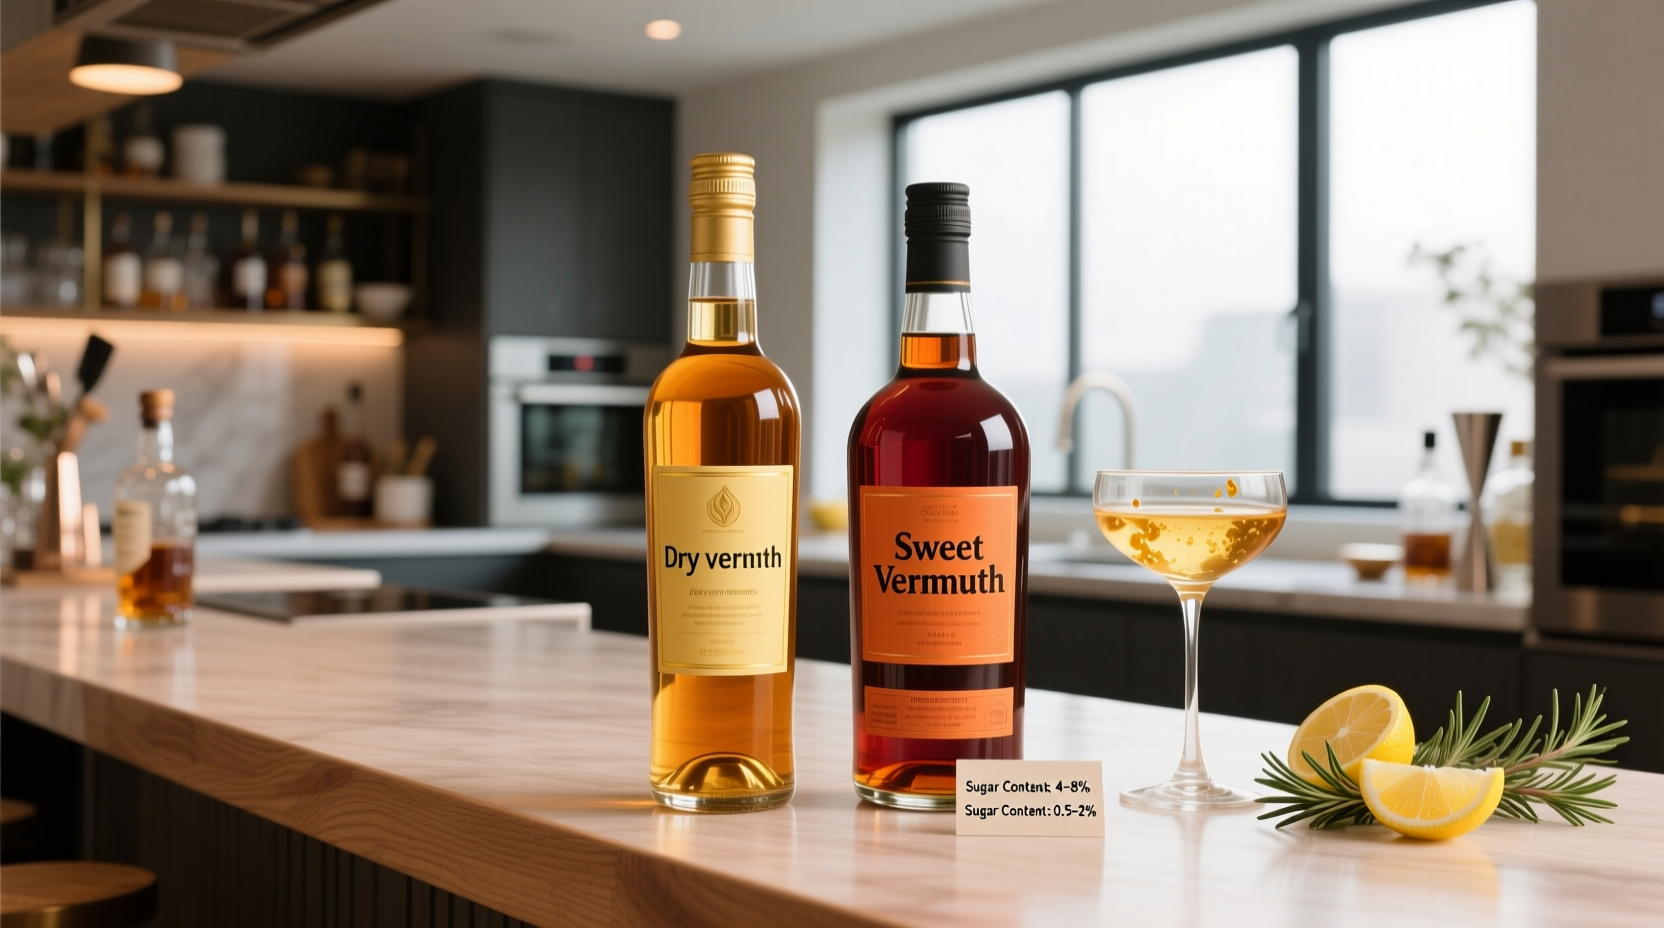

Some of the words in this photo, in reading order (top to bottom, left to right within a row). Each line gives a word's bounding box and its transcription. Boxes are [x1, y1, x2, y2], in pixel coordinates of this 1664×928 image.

[664, 545, 700, 576] Dry
[895, 531, 984, 561] Sweet
[873, 564, 1005, 595] Vermuth
[965, 780, 1000, 796] Sugar
[964, 804, 1000, 820] Sugar
[1001, 804, 1051, 817] Content:
